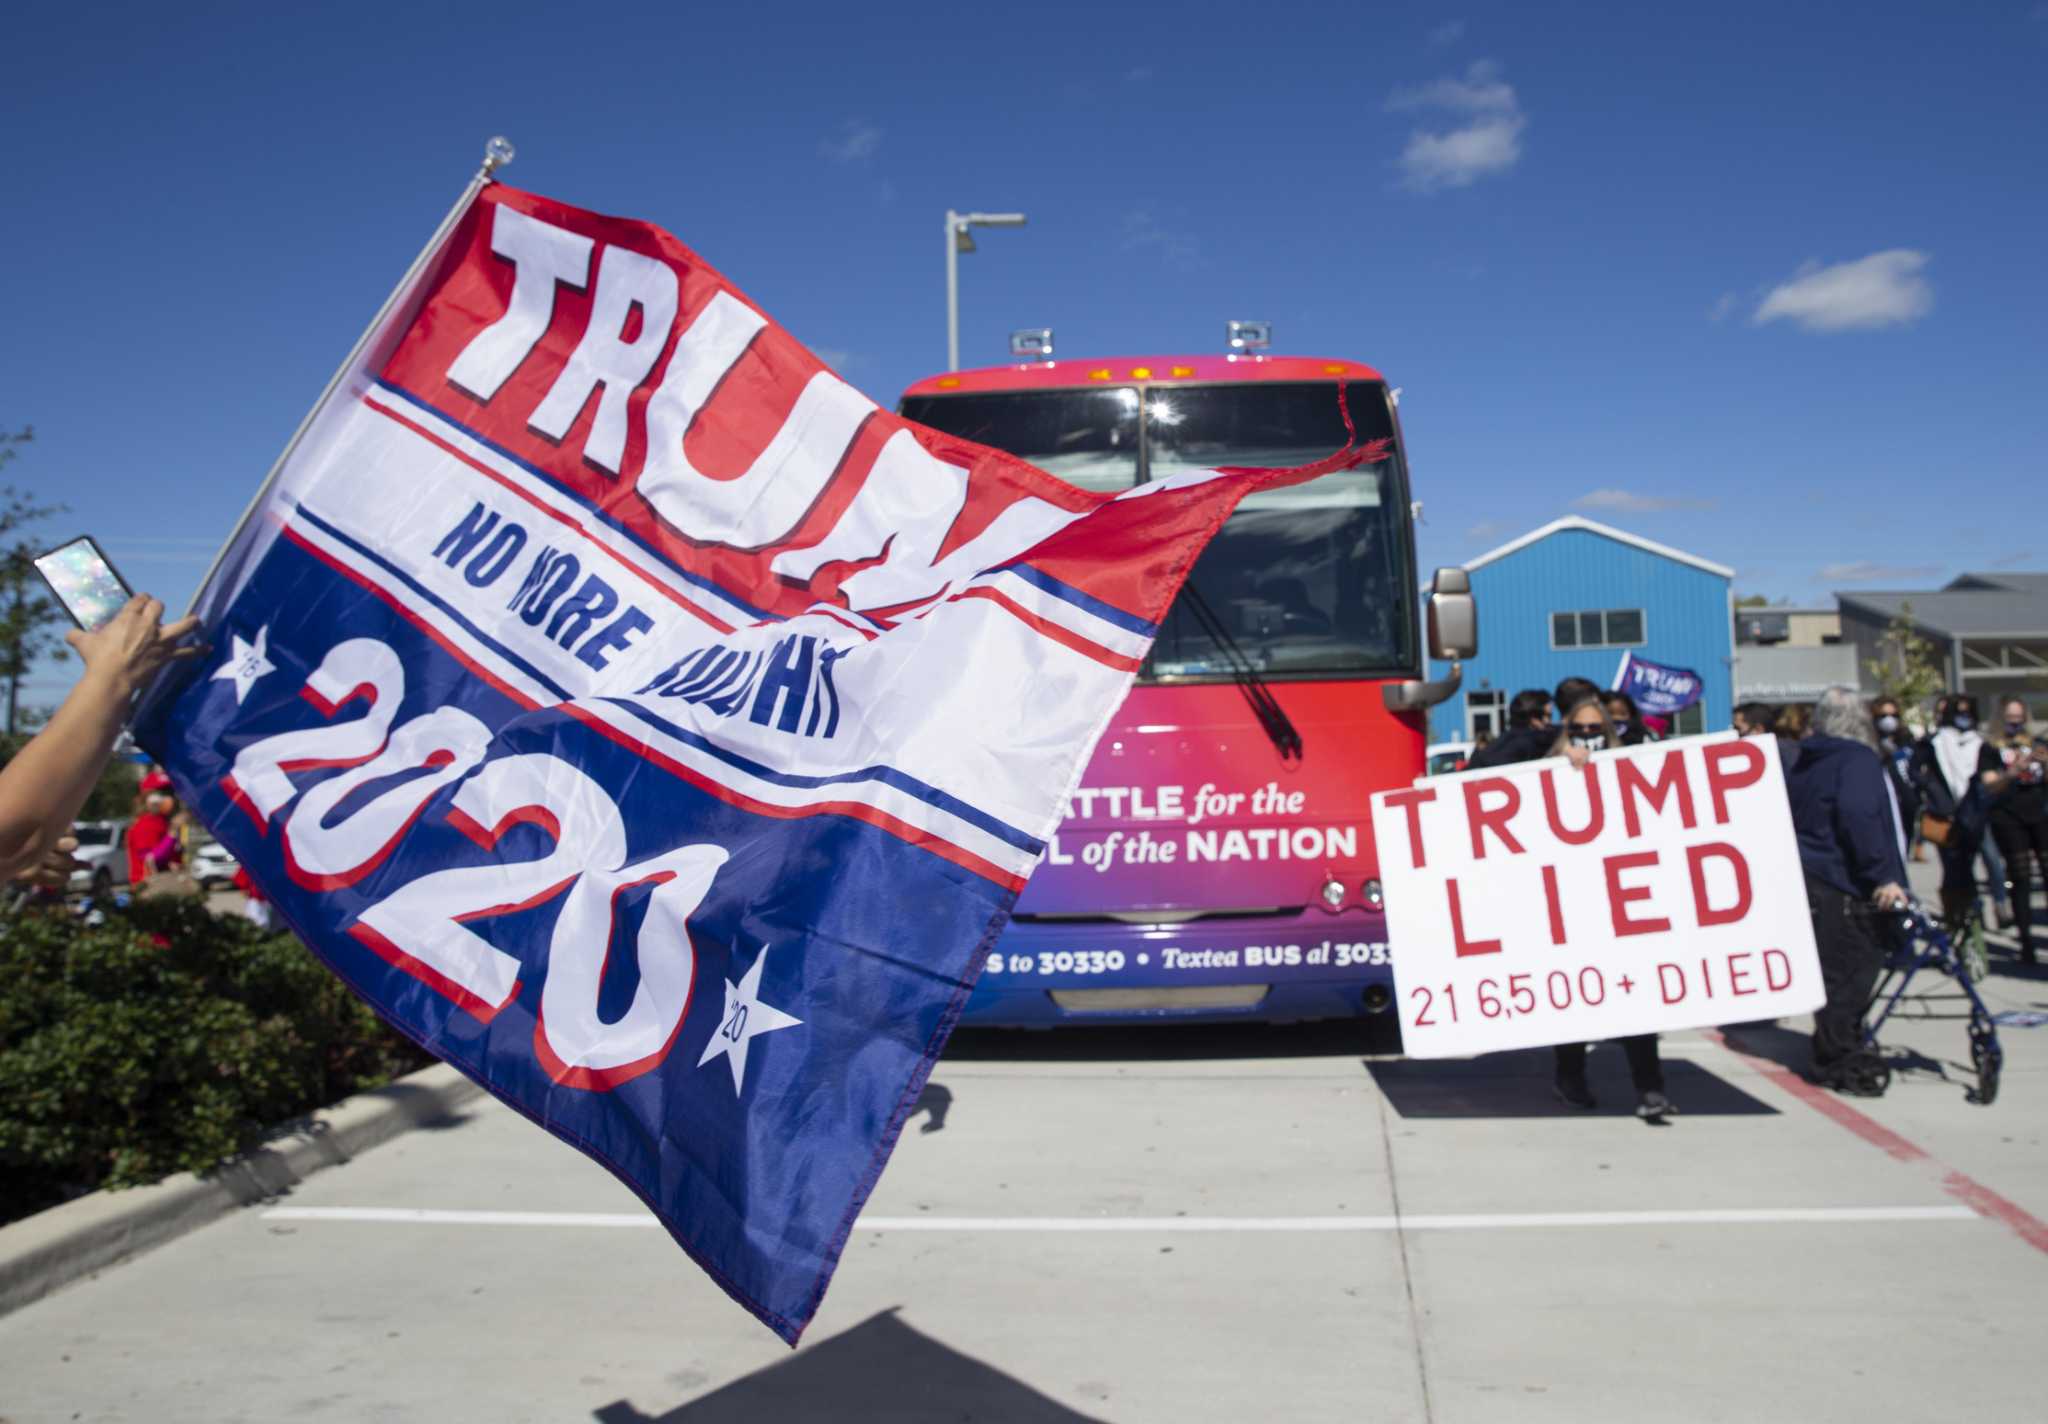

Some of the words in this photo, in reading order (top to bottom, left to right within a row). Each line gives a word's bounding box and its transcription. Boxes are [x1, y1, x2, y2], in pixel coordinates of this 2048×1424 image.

[446, 203, 1226, 612] TRUM
[432, 501, 528, 588] NO
[1187, 783, 1245, 825] for
[1252, 782, 1306, 816] the
[1384, 741, 1766, 868] TRUMP
[222, 638, 729, 1088] 2020
[1082, 831, 1124, 872] of
[1124, 831, 1178, 864] the
[1186, 826, 1357, 862] NATION
[1446, 842, 1752, 957] LIED
[1009, 954, 1034, 973] to
[1038, 950, 1125, 975] 30330
[1162, 947, 1239, 969] Textea
[1245, 945, 1302, 967] BUS
[1306, 941, 1331, 965] al
[1657, 949, 1793, 1004] DIED
